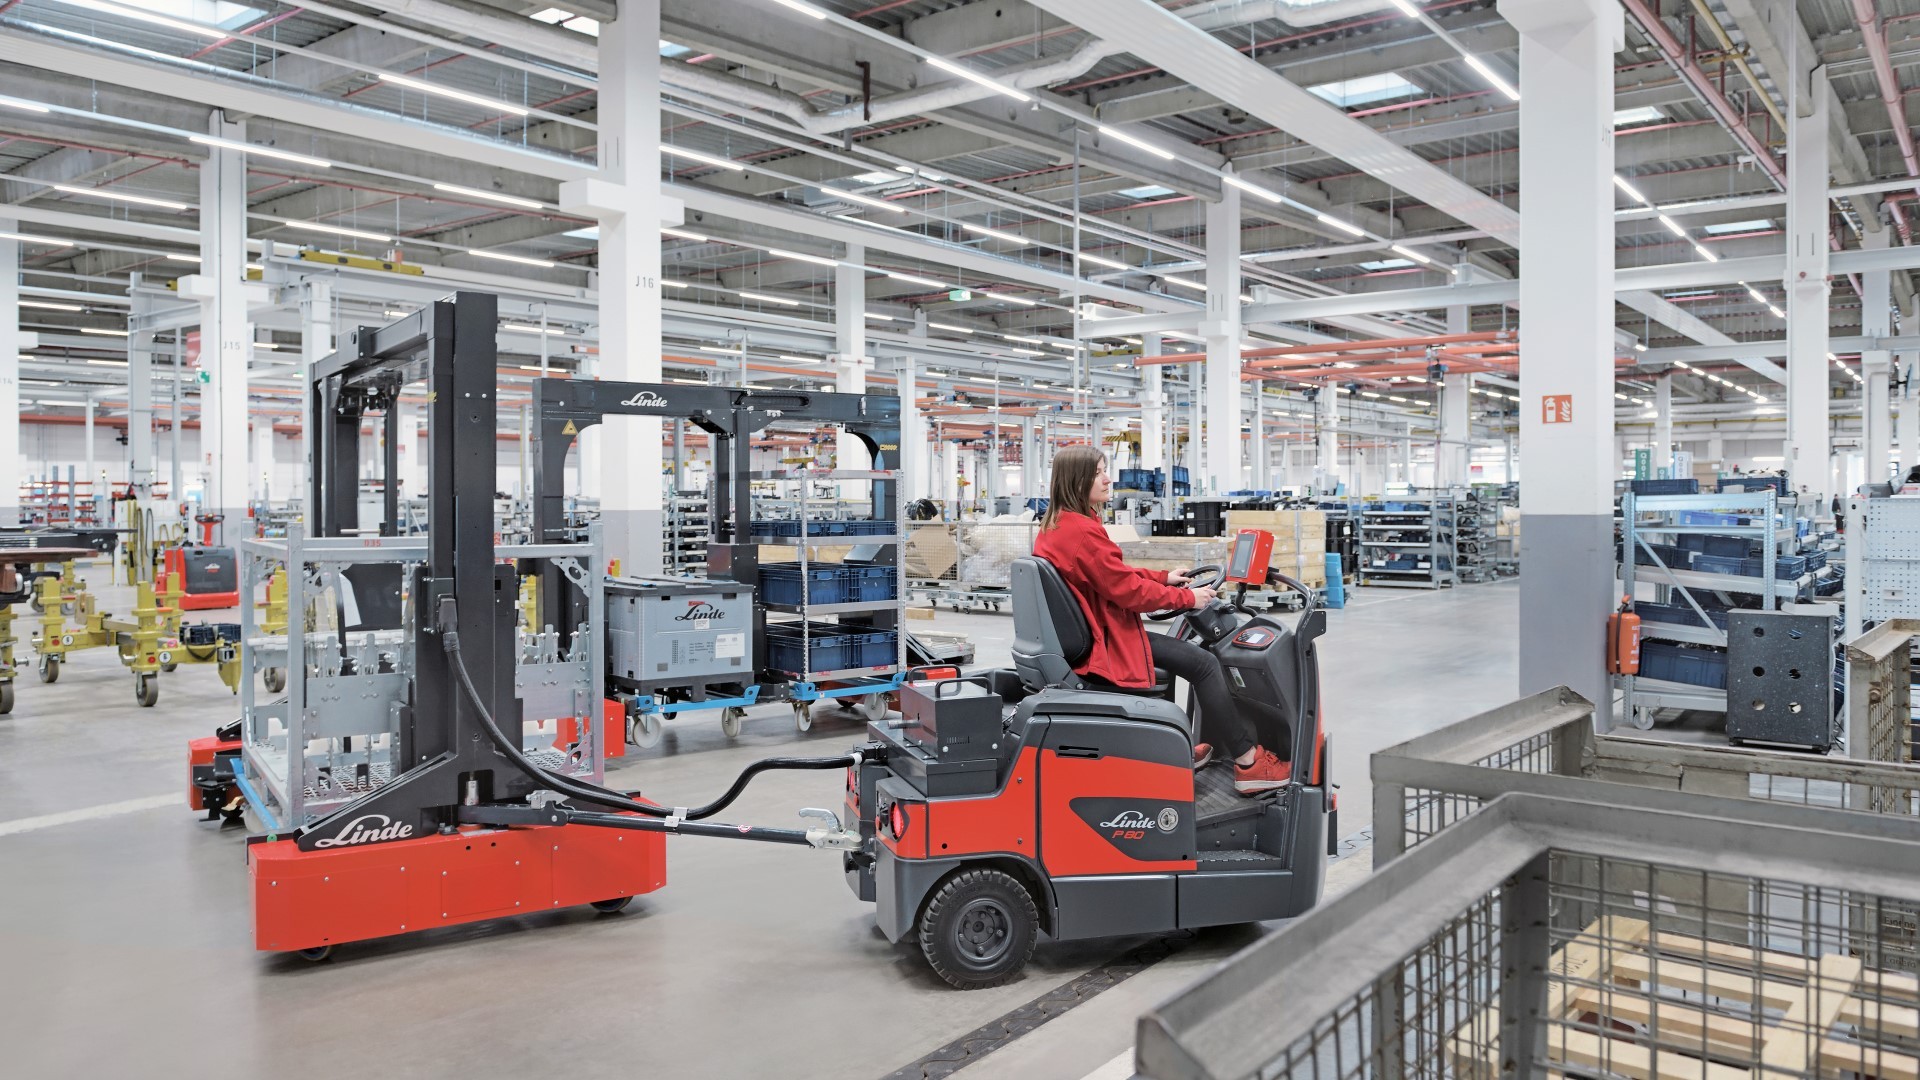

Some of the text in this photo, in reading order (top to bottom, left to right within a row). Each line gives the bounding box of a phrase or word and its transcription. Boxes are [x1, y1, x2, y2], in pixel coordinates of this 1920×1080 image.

[635, 275, 654, 288] J16
[223, 341, 241, 350] J15
[620, 390, 668, 407] Linde
[675, 603, 725, 621] Linde
[1099, 810, 1156, 829] Linde
[314, 814, 413, 848] Linde
